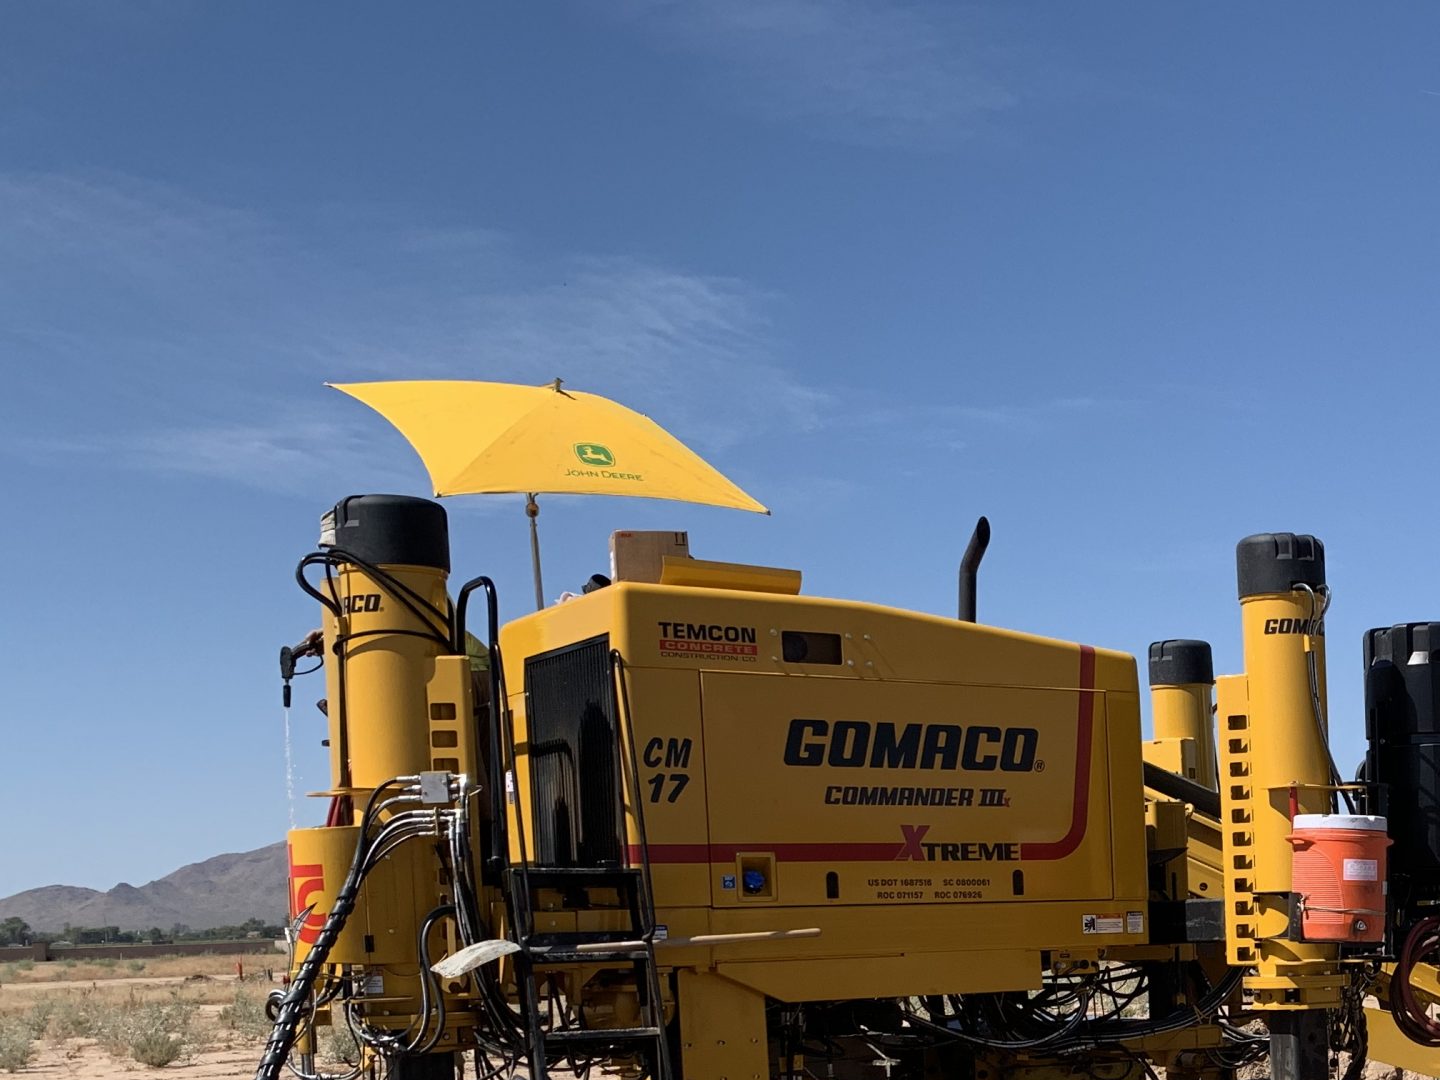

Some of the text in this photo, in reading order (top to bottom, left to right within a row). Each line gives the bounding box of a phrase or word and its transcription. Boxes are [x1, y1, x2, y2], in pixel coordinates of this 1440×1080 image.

[564, 469, 644, 481] JOHN DEERE
[658, 622, 756, 643] TEMCON
[661, 652, 739, 661] CONSTRUCTION
[665, 641, 753, 653] CONCRETE
[643, 737, 693, 768] CM
[648, 773, 690, 803] 17
[824, 786, 974, 806] COMMANDER
